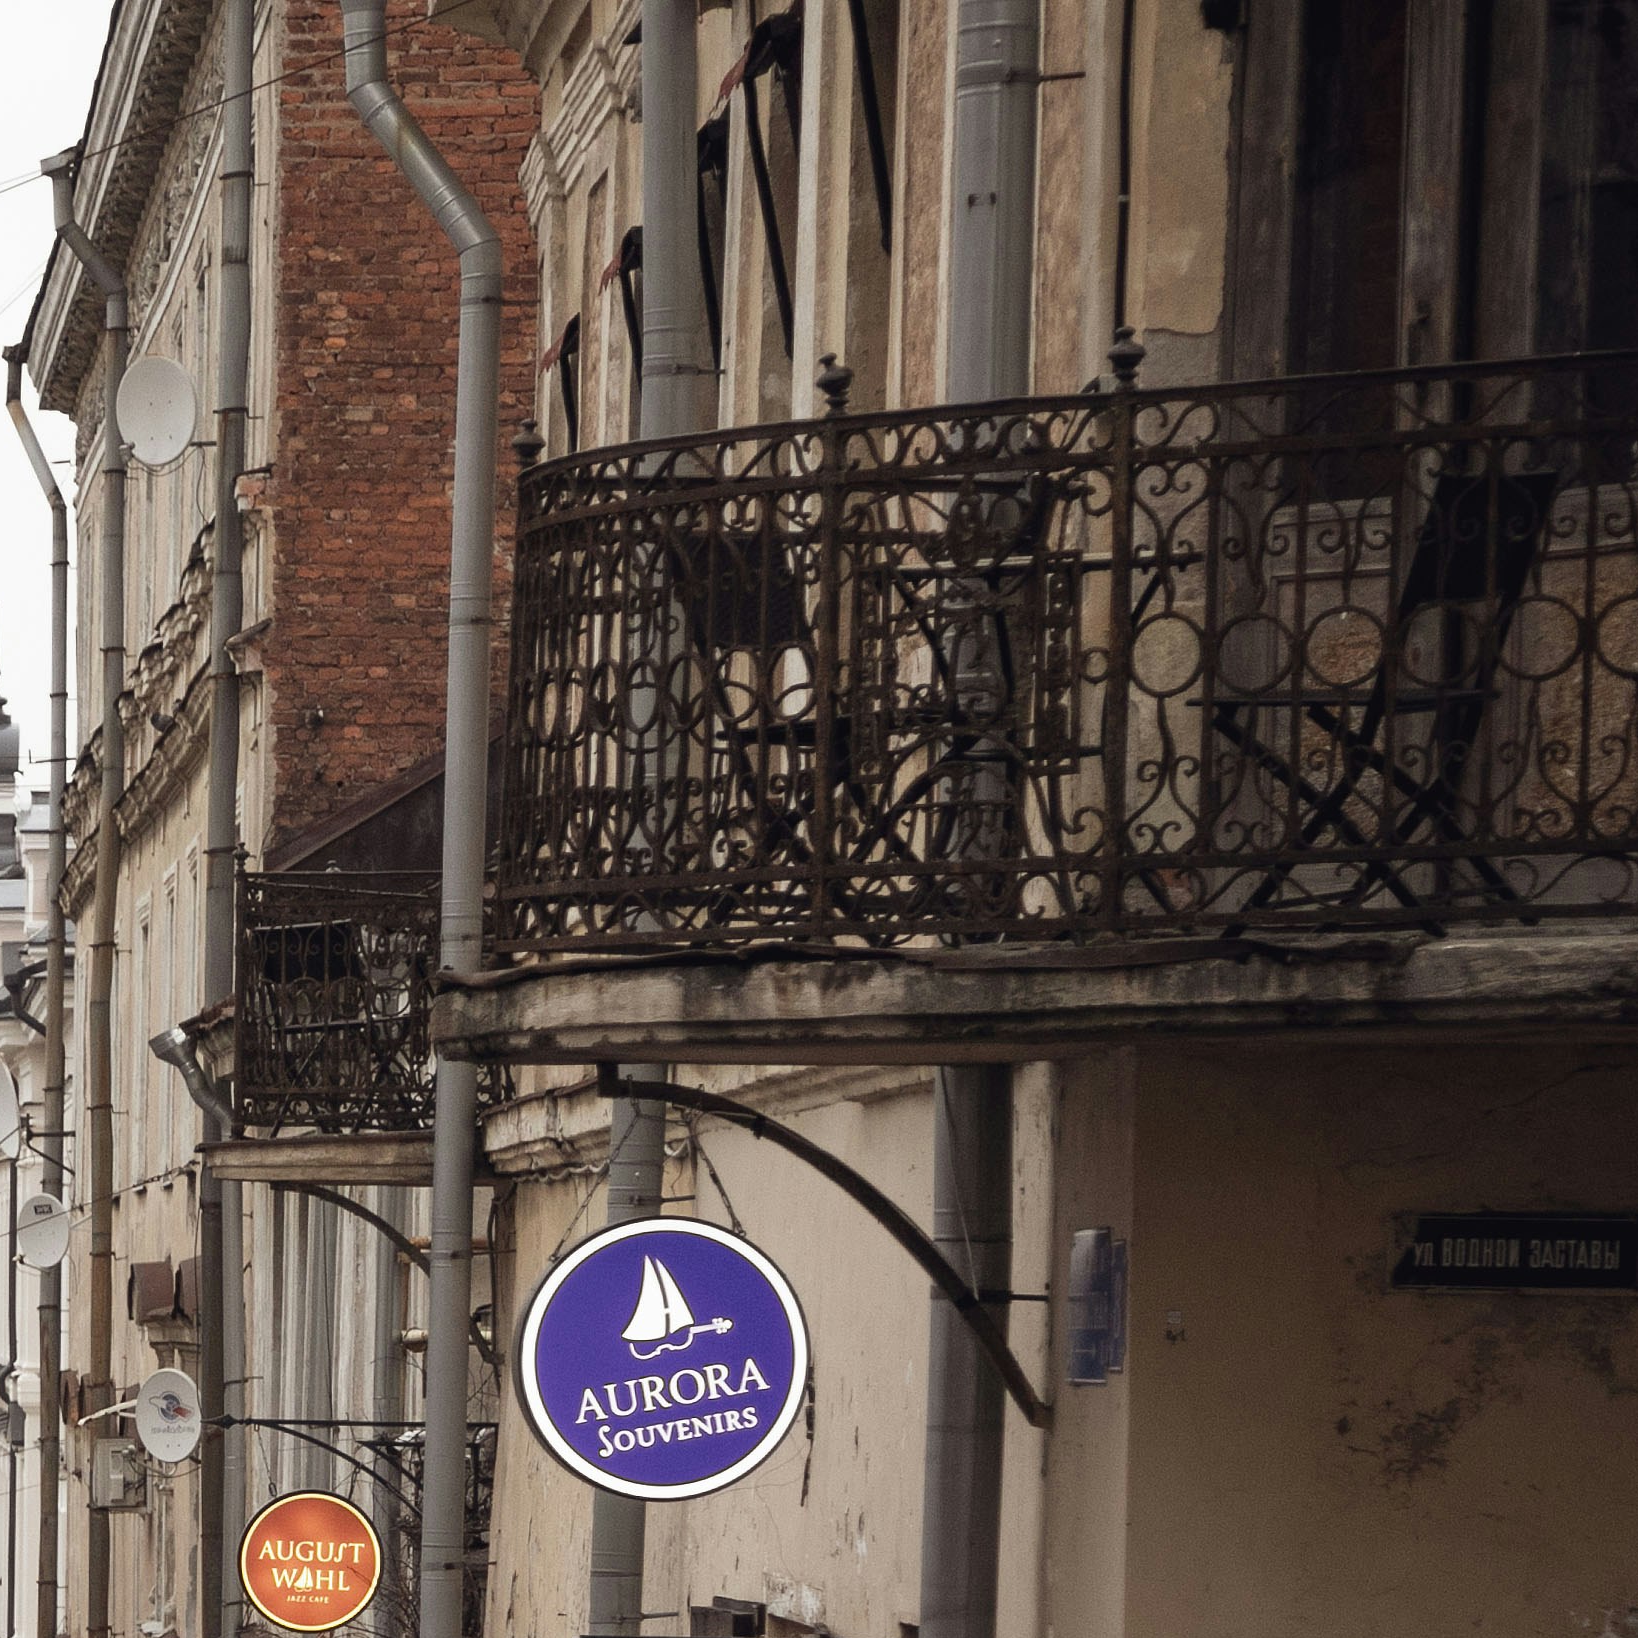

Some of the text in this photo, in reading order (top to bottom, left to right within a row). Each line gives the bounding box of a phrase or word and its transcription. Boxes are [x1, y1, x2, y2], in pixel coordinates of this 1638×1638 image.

[1529, 1238, 1621, 1270] ЗАСТАВЫ
[575, 1357, 771, 1425] AURORA
[259, 1540, 365, 1564] AUGUST
[286, 1594, 330, 1604] JAZZ CAFE
